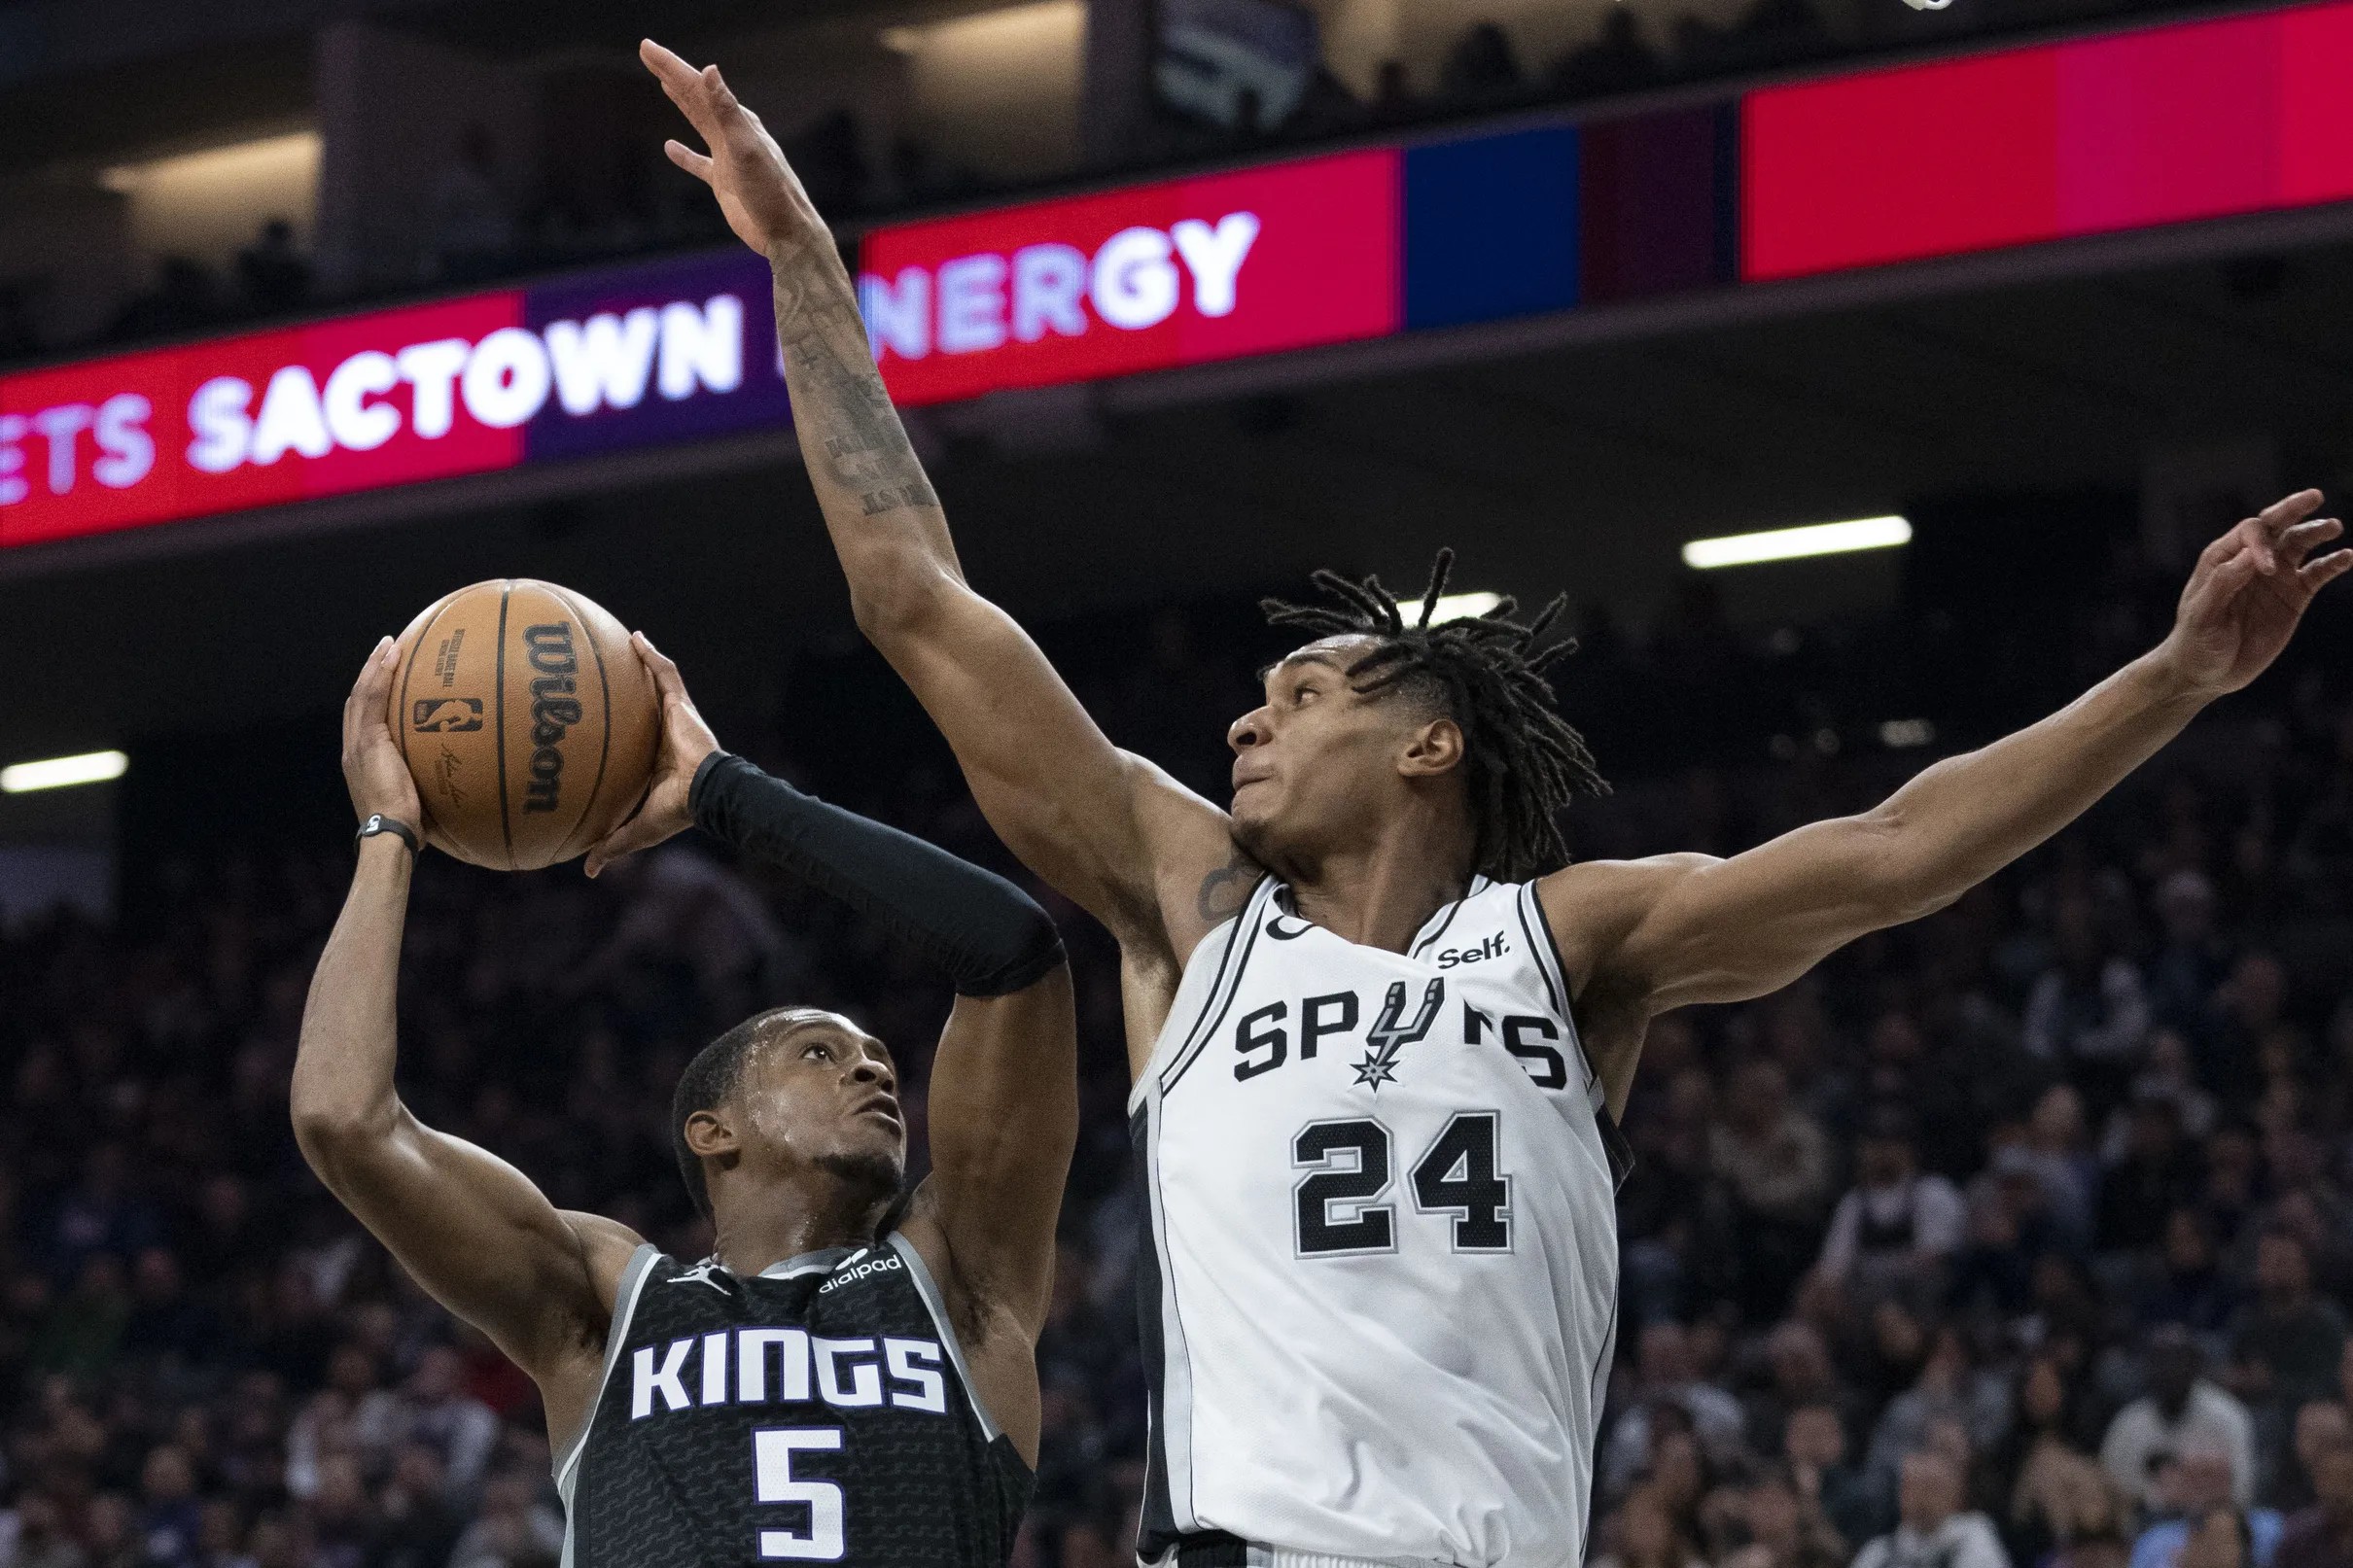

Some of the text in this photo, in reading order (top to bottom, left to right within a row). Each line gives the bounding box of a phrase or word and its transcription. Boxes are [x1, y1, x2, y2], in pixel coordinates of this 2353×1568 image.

[187, 295, 743, 473] SACTOWN
[775, 211, 1261, 379] NERGY
[524, 621, 581, 814] Wilson
[1437, 929, 1510, 969] Self.
[1290, 1109, 1515, 1260] 24
[819, 1254, 902, 1293] dialpad
[630, 1325, 949, 1421] KINGS
[751, 1425, 848, 1560] 5
